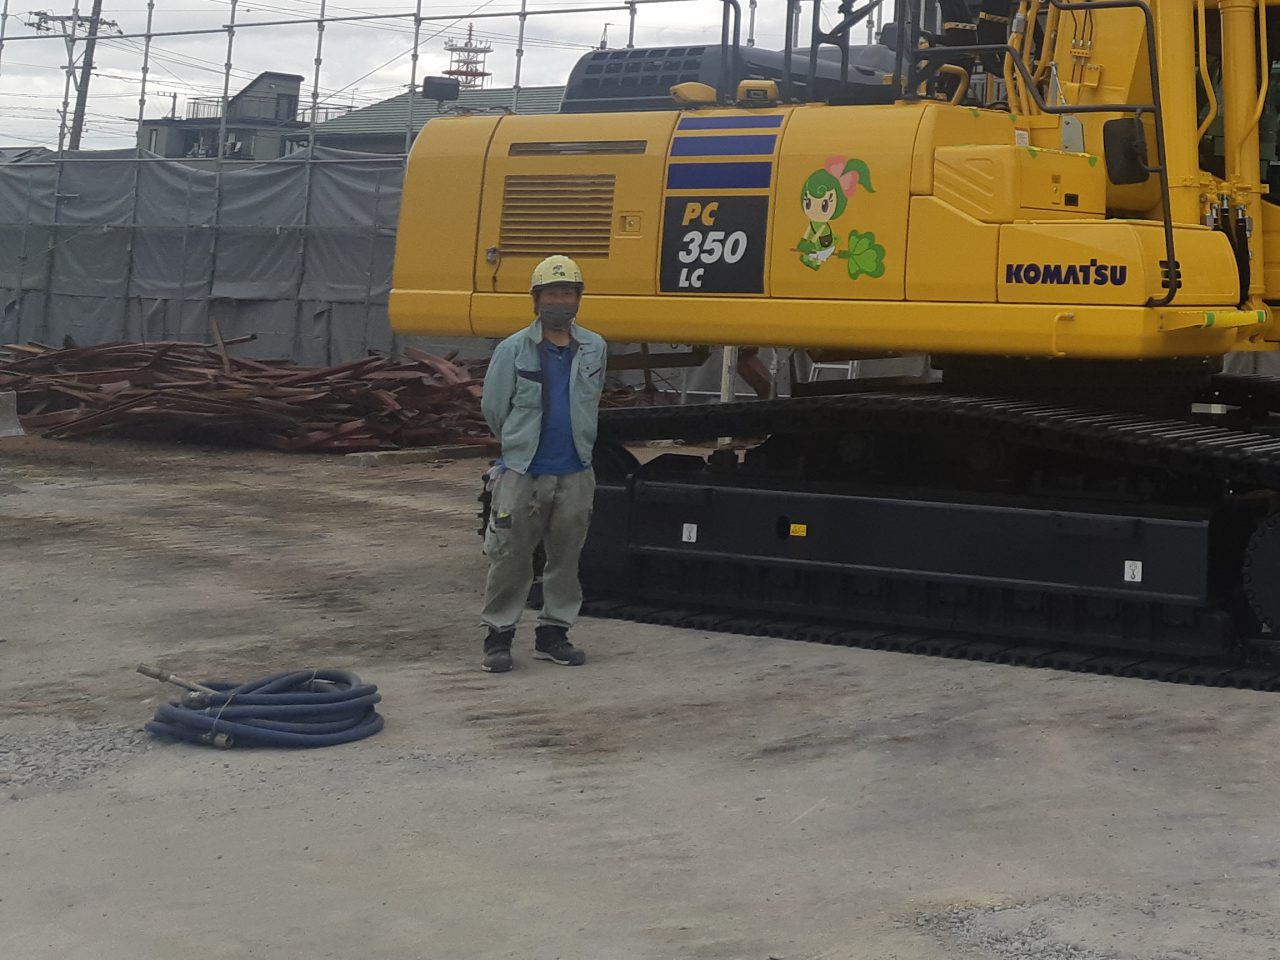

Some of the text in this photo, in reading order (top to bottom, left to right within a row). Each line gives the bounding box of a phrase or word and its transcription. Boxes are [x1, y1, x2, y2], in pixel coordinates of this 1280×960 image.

[682, 201, 719, 226] PC
[678, 230, 748, 264] 350
[678, 268, 705, 288] LC
[1005, 258, 1127, 286] KOMATSU
